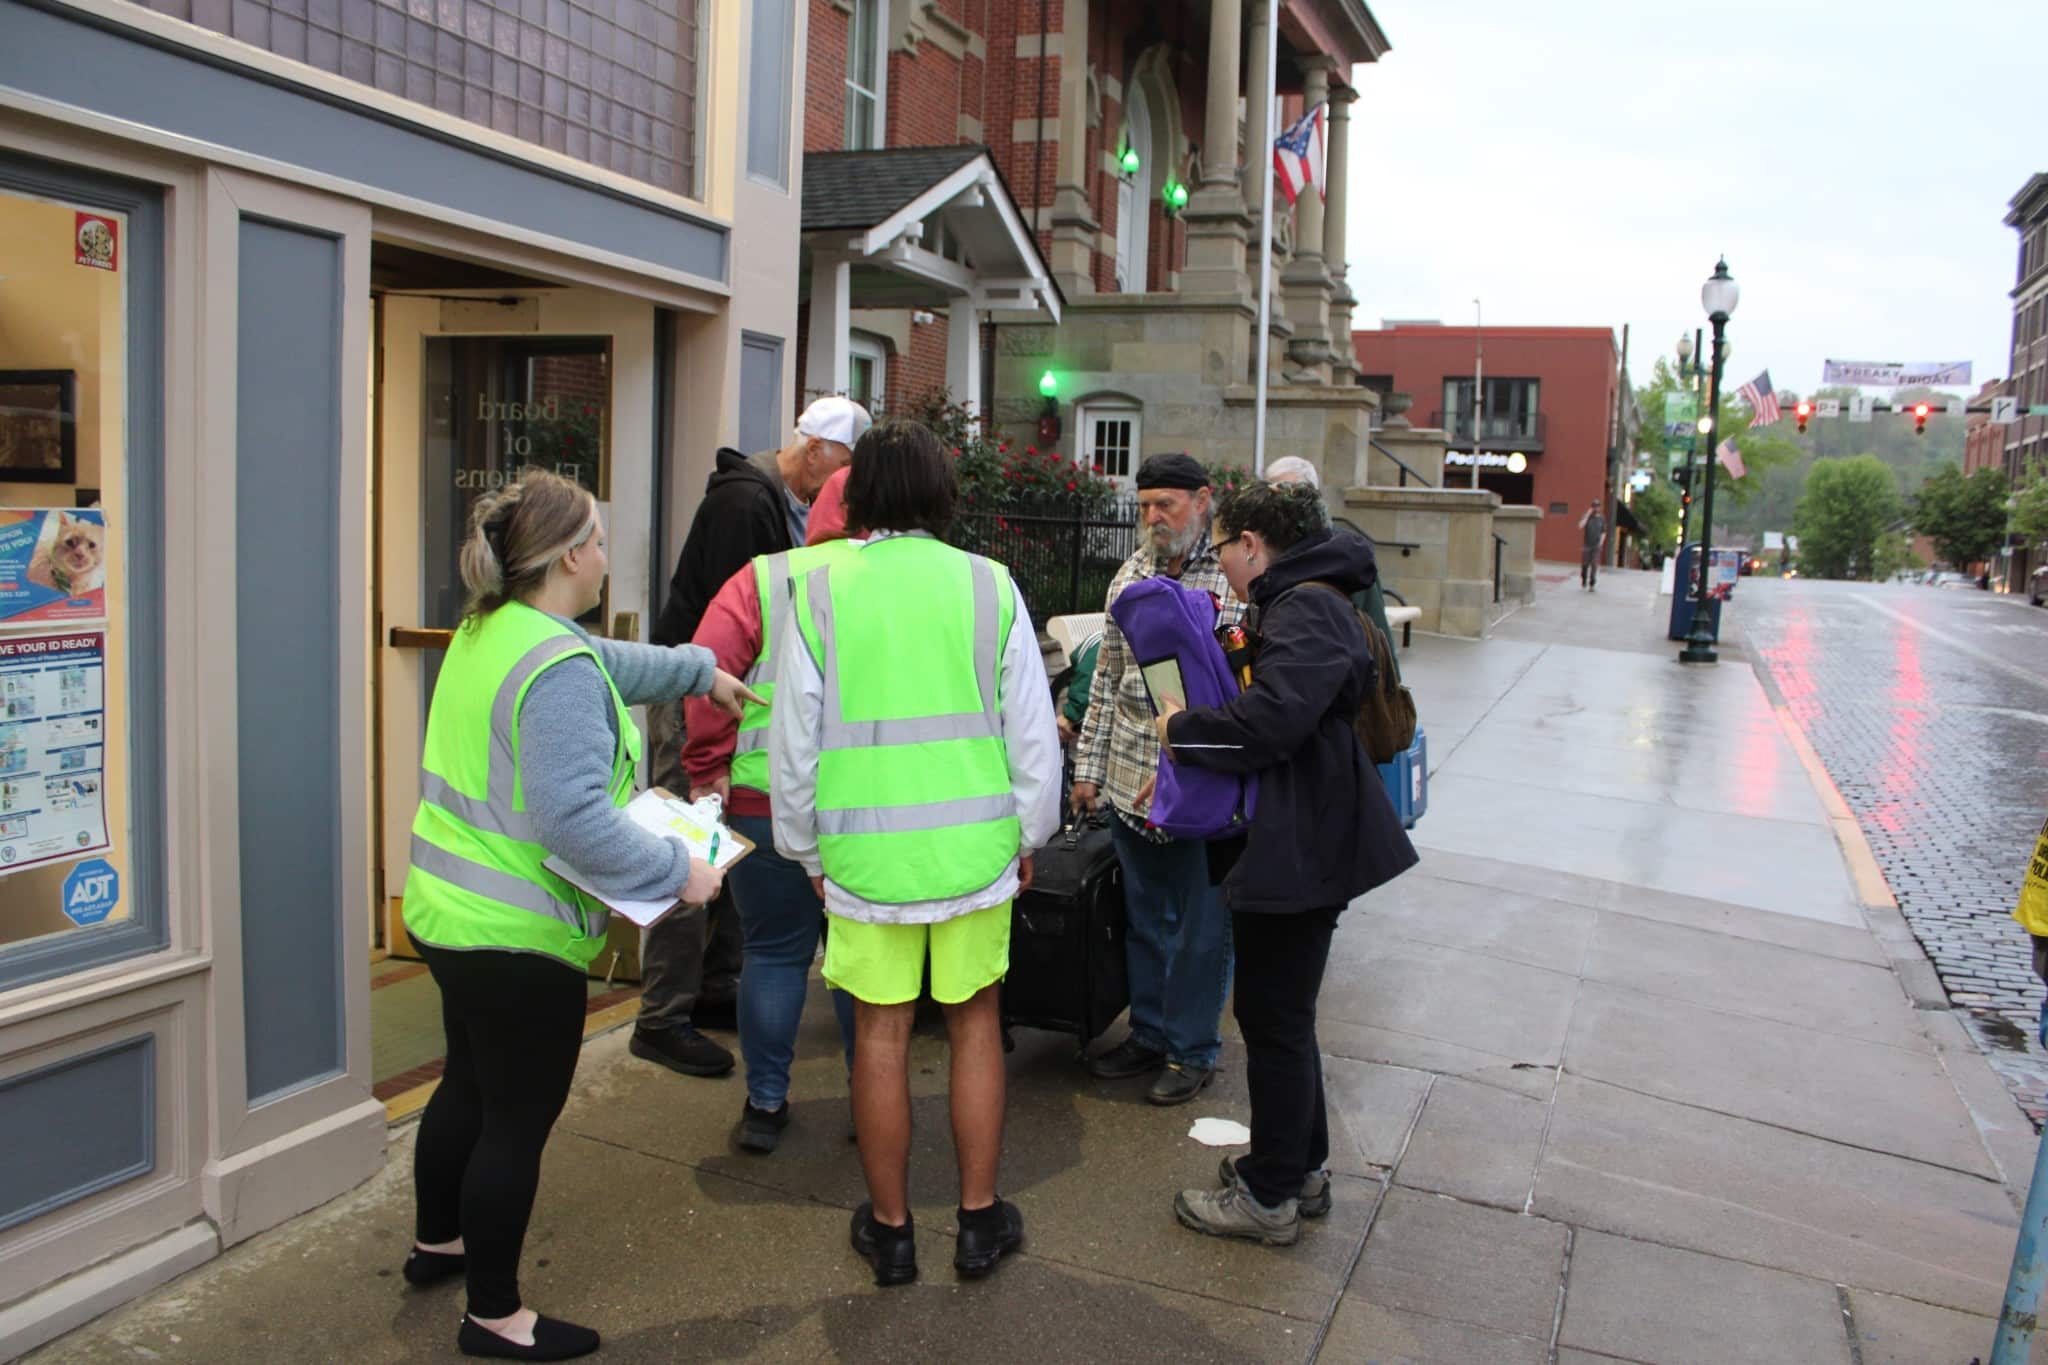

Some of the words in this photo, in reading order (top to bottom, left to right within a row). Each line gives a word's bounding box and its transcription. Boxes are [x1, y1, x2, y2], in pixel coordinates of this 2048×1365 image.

[16, 642, 46, 653] YOUR
[48, 641, 60, 650] ID
[62, 638, 96, 649] READY
[69, 874, 114, 906] ADT
